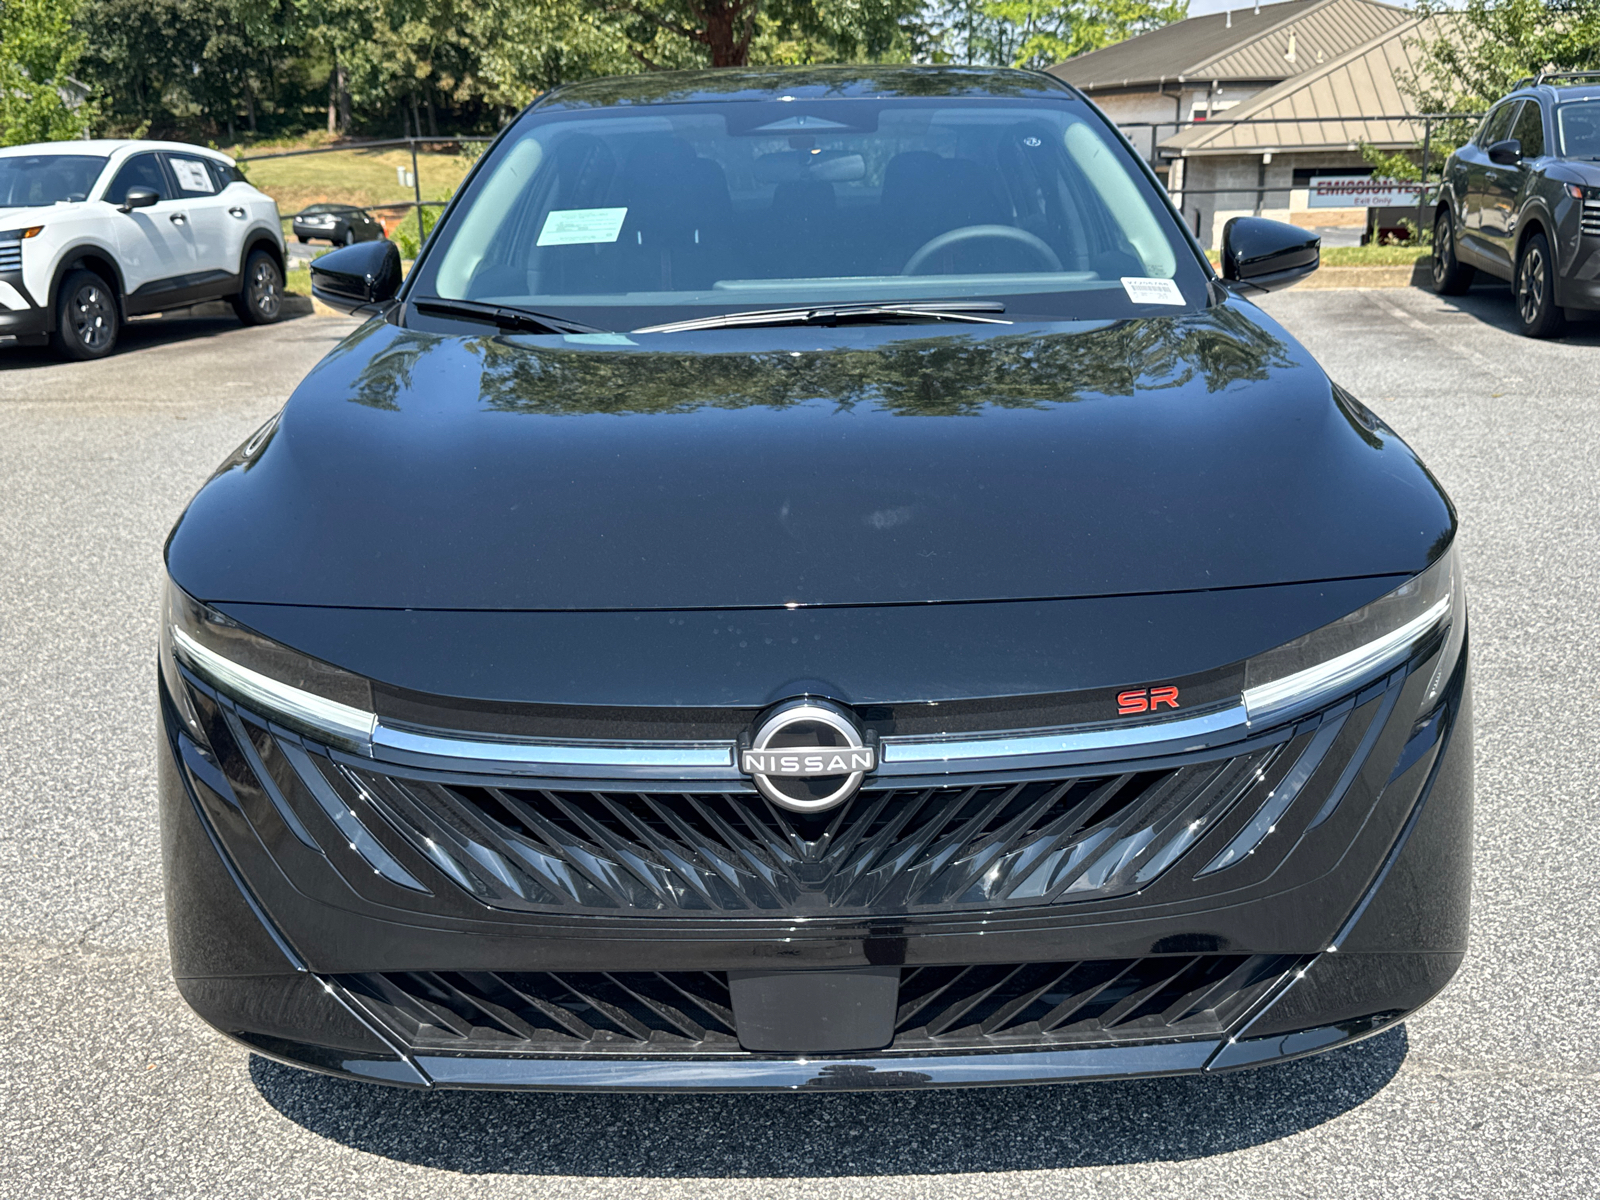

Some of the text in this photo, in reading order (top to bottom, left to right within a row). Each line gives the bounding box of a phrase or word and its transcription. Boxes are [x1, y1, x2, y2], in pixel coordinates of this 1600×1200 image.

[1317, 180, 1393, 196] EMISSION
[1354, 196, 1392, 206] Exit Only
[1117, 685, 1180, 715] SR
[745, 752, 871, 772] NISSAN
